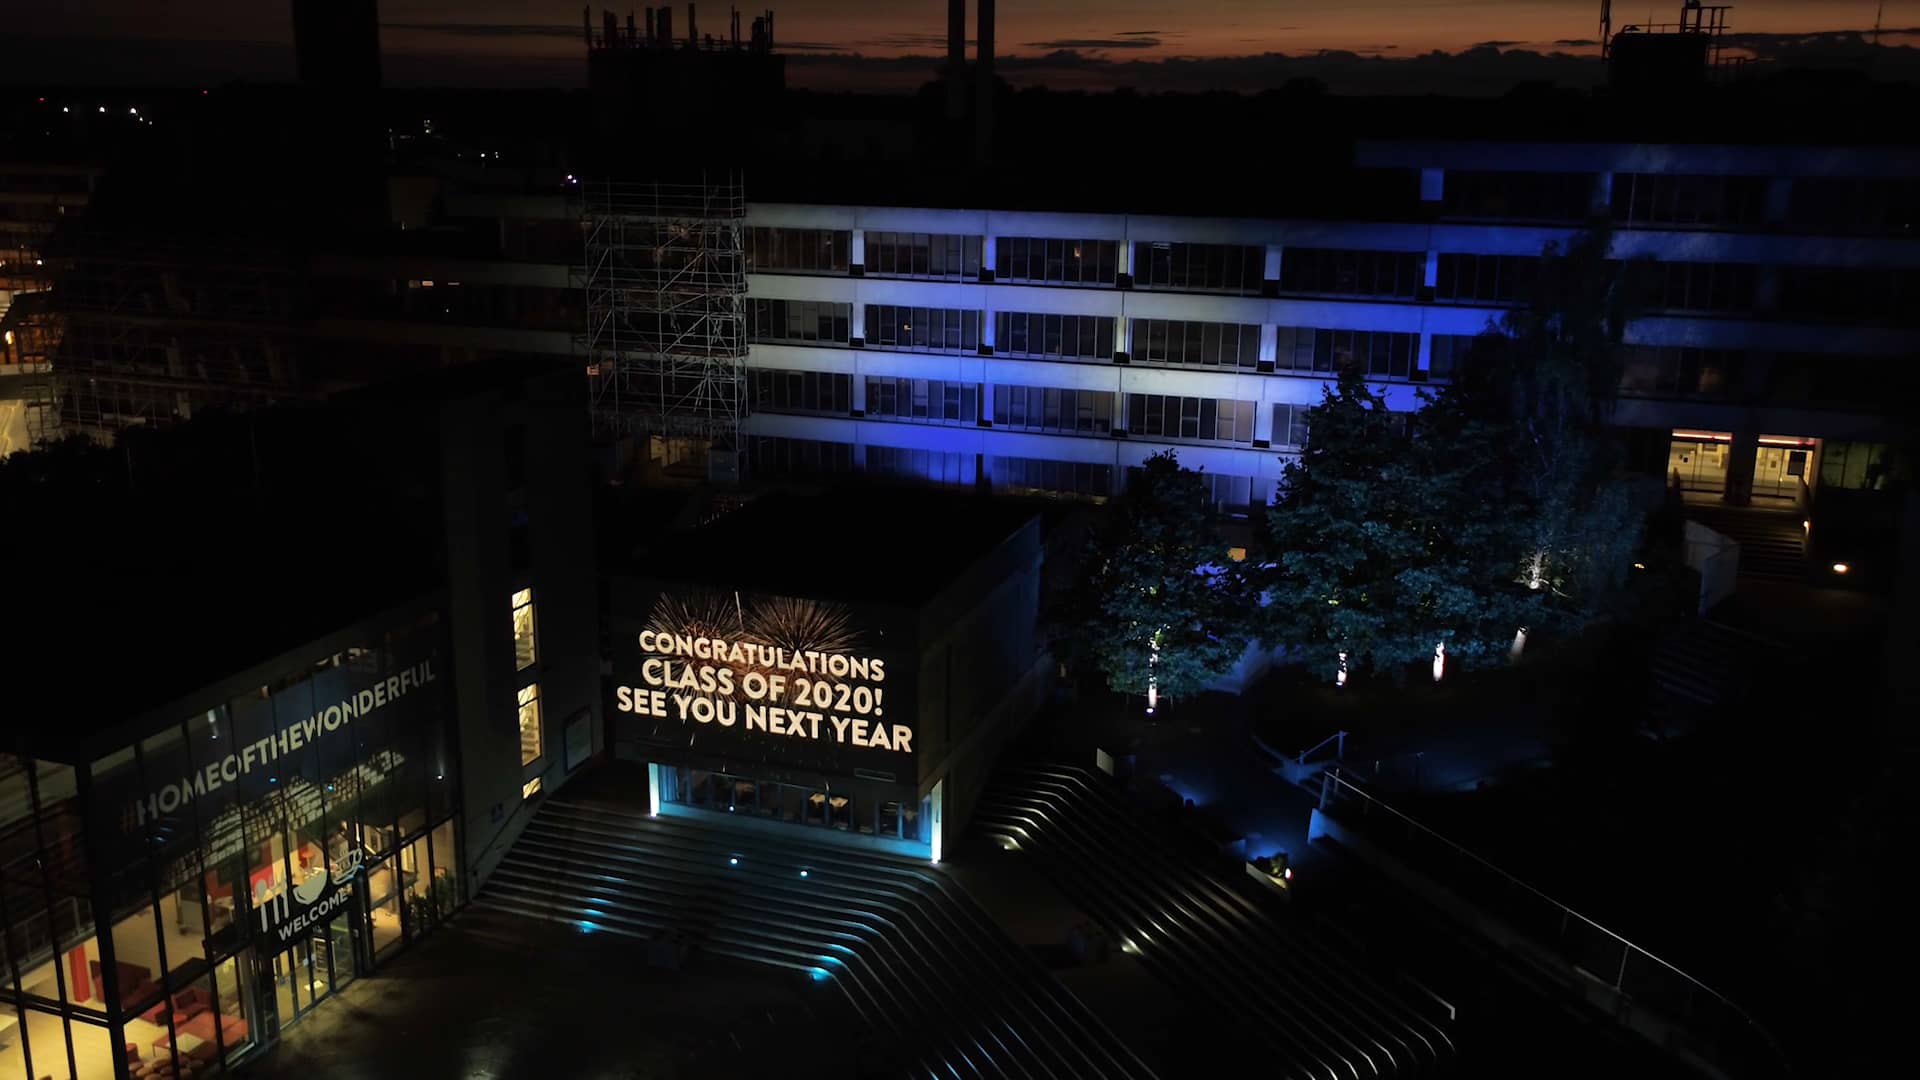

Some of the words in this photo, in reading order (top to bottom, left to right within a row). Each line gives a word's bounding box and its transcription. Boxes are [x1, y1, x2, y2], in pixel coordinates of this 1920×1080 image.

[639, 630, 885, 682] CONGRATULATIONS
[642, 660, 734, 696] CLASS
[742, 673, 786, 702] OF
[795, 678, 884, 717] 2020!
[616, 686, 667, 718] SEE
[673, 694, 736, 727] YOU
[745, 704, 823, 739] NEXT
[830, 717, 912, 753] YEAR
[278, 886, 350, 942] WELCOME
